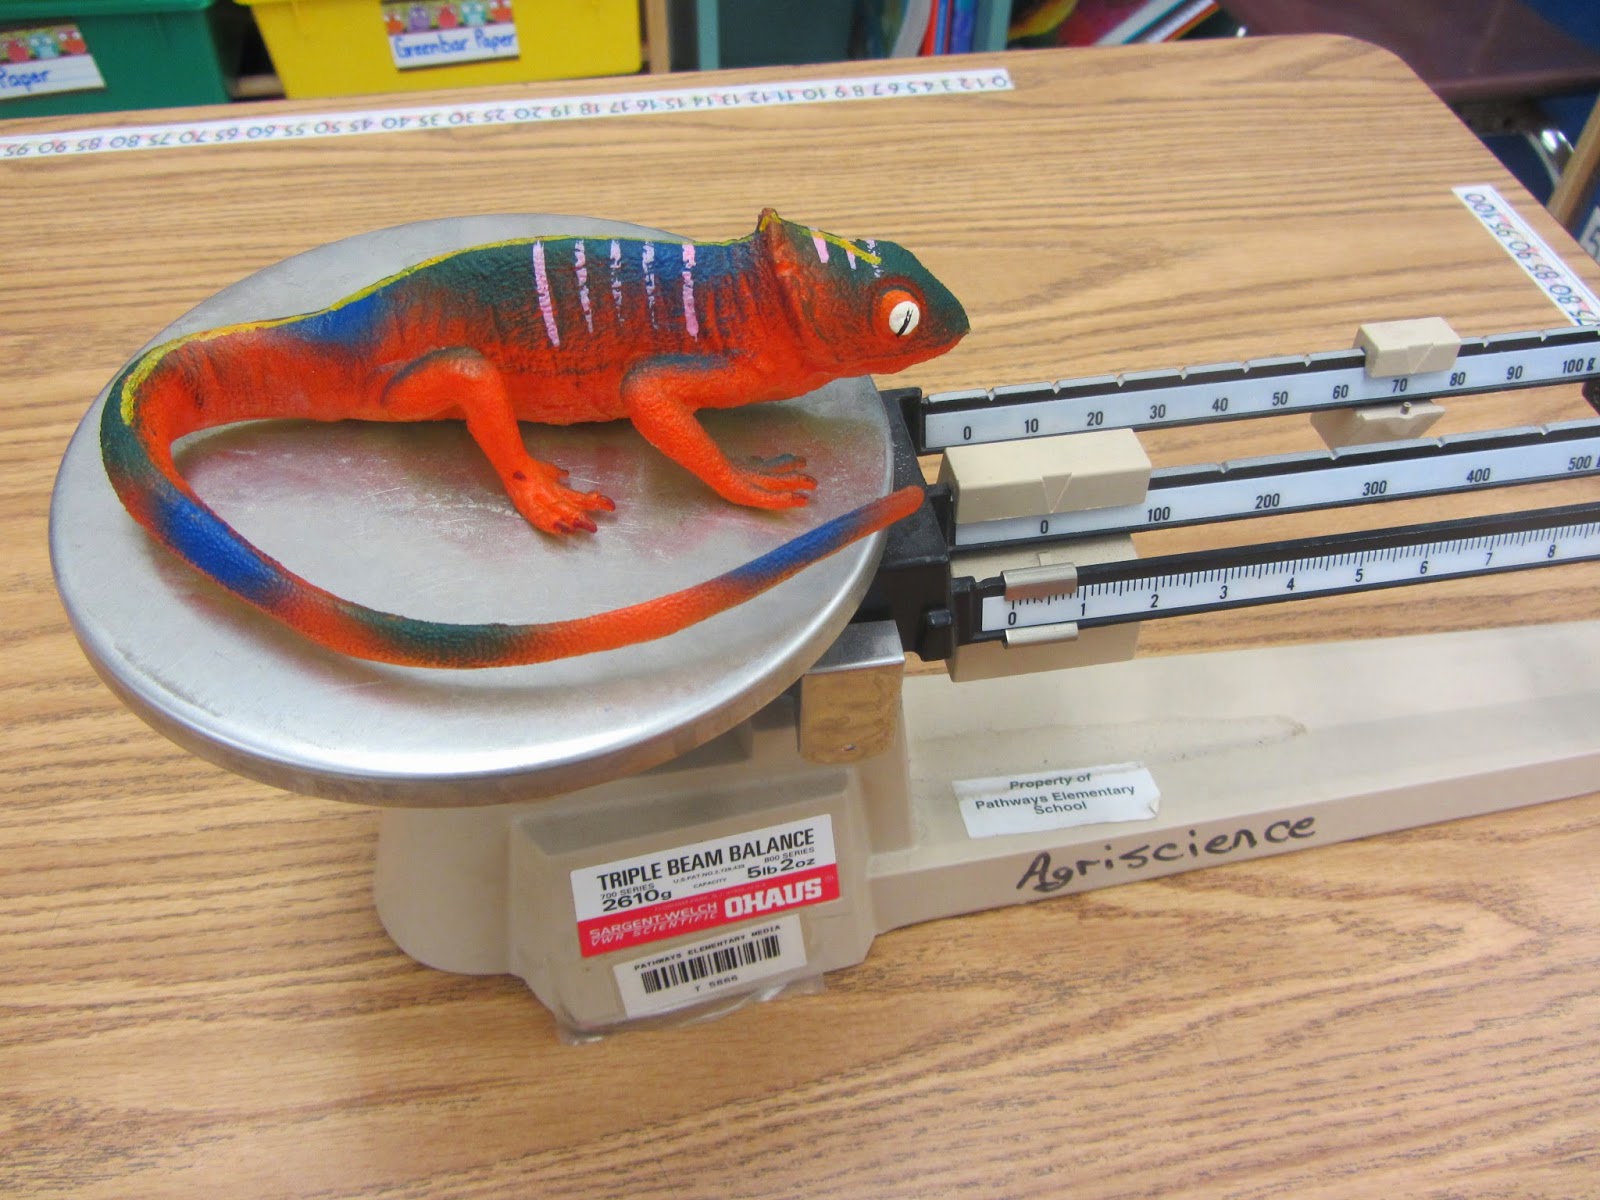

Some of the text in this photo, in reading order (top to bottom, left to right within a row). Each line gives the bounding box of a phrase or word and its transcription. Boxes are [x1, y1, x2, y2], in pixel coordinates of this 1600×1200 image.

[394, 28, 516, 58] Greenbar Paper
[692, 95, 713, 107] 14
[723, 93, 739, 106] 13
[750, 91, 768, 104] 12
[802, 87, 826, 101] 10
[550, 104, 570, 117] 19
[580, 102, 600, 115] 18
[609, 100, 629, 113] 17
[639, 98, 657, 111] 16
[665, 96, 684, 110] 15
[419, 114, 439, 127] 35
[448, 111, 473, 125] 30
[483, 108, 505, 122] 25
[513, 107, 542, 120] 20
[314, 120, 341, 134] 50
[350, 118, 373, 131] 45
[381, 116, 410, 129] 40
[179, 130, 207, 144] 70
[215, 127, 239, 141] 65
[246, 124, 276, 139] 60
[284, 124, 305, 137] 55
[76, 136, 102, 151] 85
[109, 134, 141, 149] 80
[149, 131, 174, 146] 75
[3, 142, 29, 158] 95
[38, 139, 67, 154] 90
[1465, 193, 1496, 219] 100
[1488, 221, 1521, 238] 95
[1509, 241, 1542, 260] 90
[1526, 263, 1560, 280] 85
[1550, 284, 1582, 304] 80
[963, 357, 1597, 441] 0 10 20 30 40 50 60 70 80 90 100 g
[1040, 519, 1049, 534] 0
[1147, 506, 1171, 522] 100
[1255, 492, 1281, 510] 200
[1362, 480, 1388, 497] 300
[1466, 467, 1491, 483] 400
[1567, 455, 1592, 471] 500
[1007, 544, 1557, 626] 0 1 2 3 4 5 6 7 8
[1009, 773, 1091, 790] Property of
[975, 785, 1135, 810] Pathways Elementary
[1034, 801, 1088, 815] School
[597, 828, 814, 891] TRIPLE BEAM BALANCE
[1016, 816, 1316, 893] Agriscience
[600, 891, 618, 901] 700
[620, 883, 655, 898] SERIES
[764, 854, 780, 864] 800
[783, 847, 815, 860] SERIES
[602, 889, 672, 912] 2610g
[693, 877, 727, 889] CAPACITY
[589, 901, 717, 938] SARGENT-WELCH
[724, 877, 823, 919] OHAUS
[590, 912, 717, 947] VWR SCIENTIFIC
[634, 924, 781, 971] PATHWAYS ELEMENTARY MEDIA
